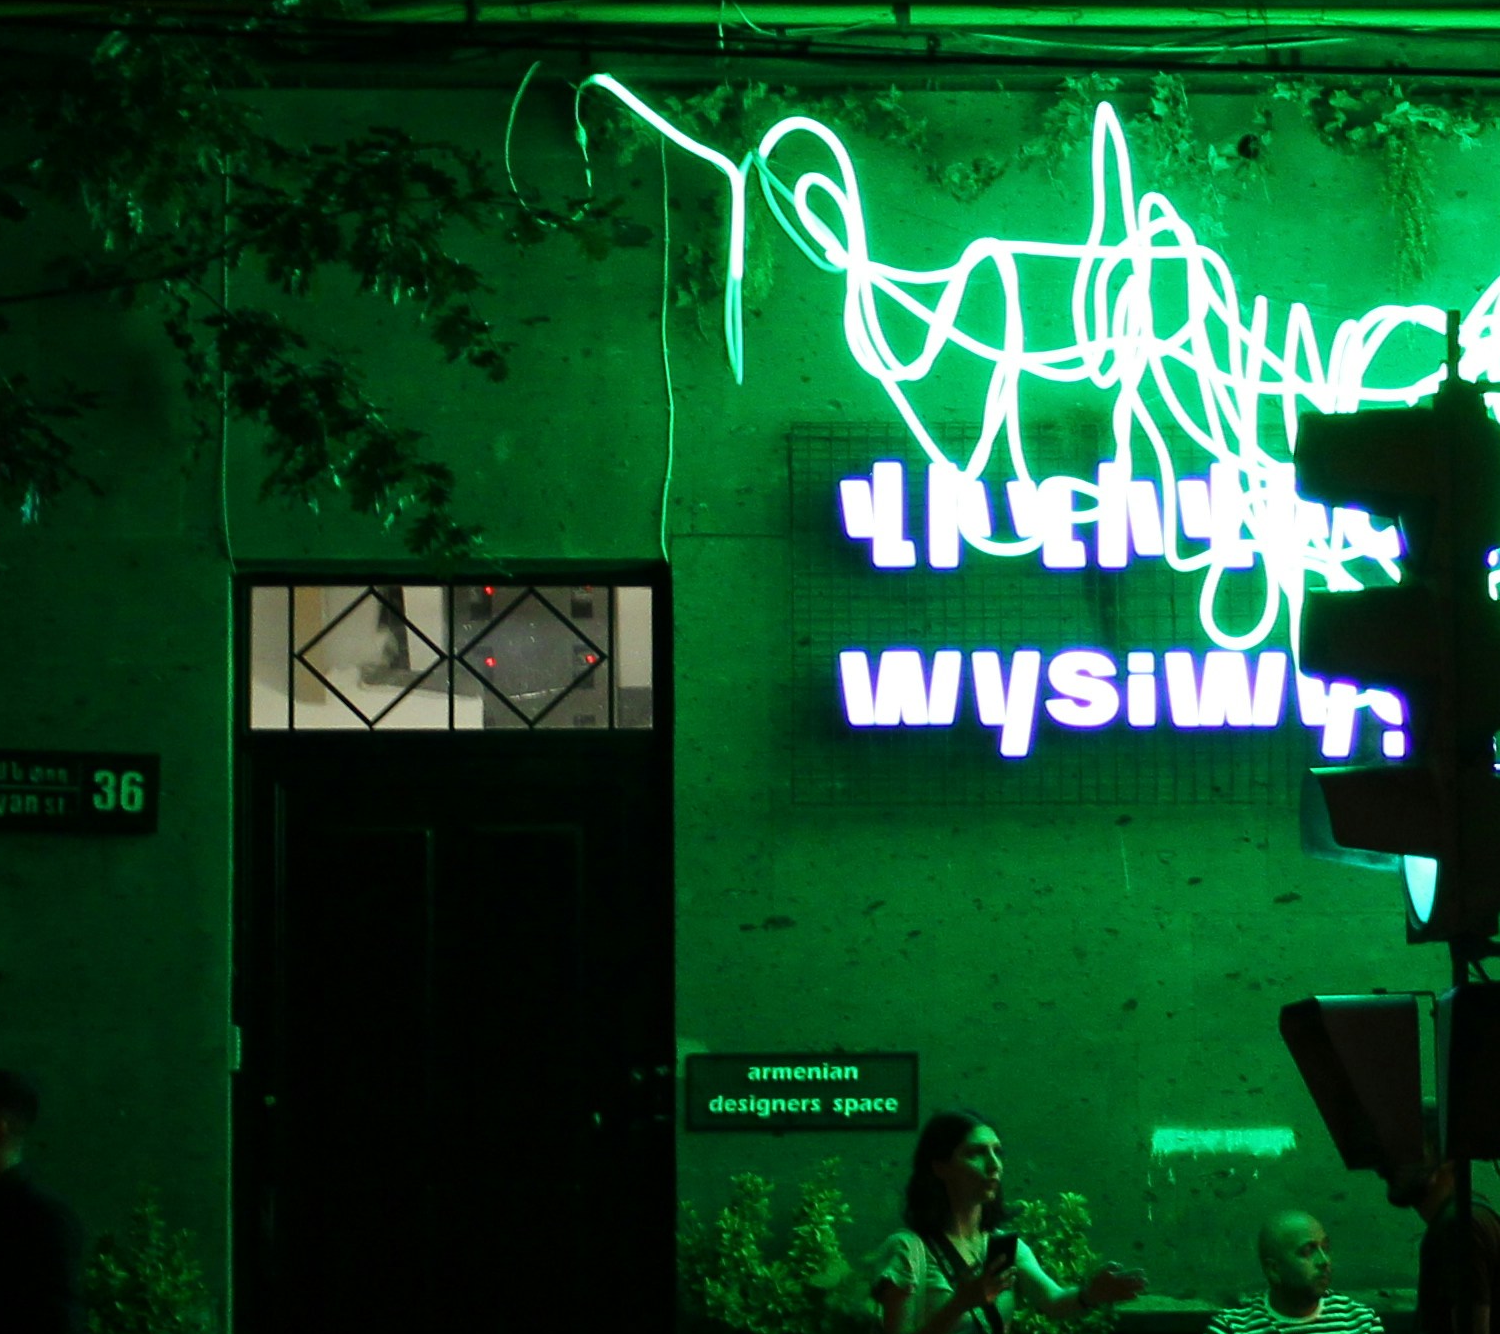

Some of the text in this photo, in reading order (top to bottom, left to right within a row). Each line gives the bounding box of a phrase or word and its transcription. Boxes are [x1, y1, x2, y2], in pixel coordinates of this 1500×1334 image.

[92, 768, 145, 813] 36
[747, 1062, 859, 1081] armenian
[708, 1094, 898, 1117] designers space
